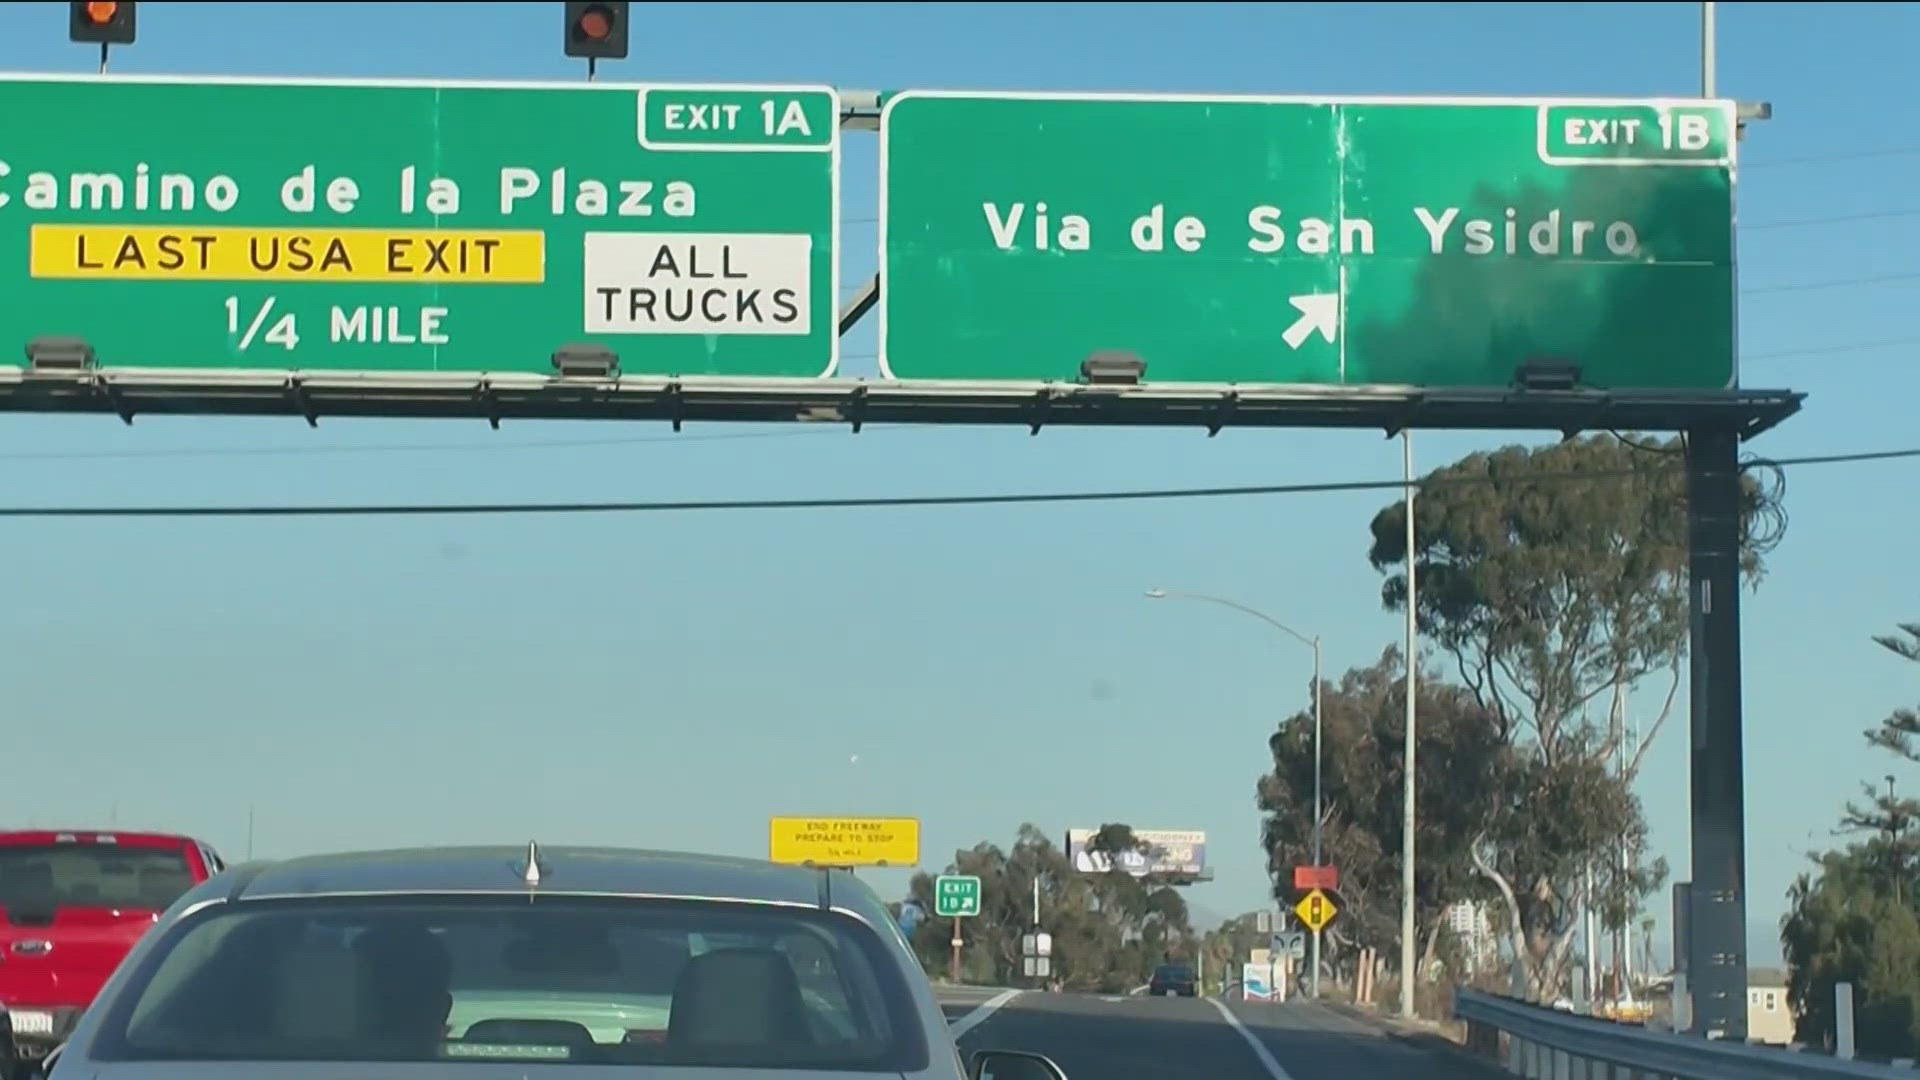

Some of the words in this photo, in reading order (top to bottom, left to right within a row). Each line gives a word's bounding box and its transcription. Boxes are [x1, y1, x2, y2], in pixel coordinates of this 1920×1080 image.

[663, 103, 742, 132] EXIT
[760, 99, 812, 136] 1A
[1564, 117, 1641, 145] EXIT
[1658, 113, 1710, 151] 1B
[281, 164, 360, 214] de
[401, 165, 461, 215] la
[500, 166, 697, 217] Plaza
[983, 202, 1091, 251] Via
[1131, 203, 1207, 252] de
[1248, 203, 1375, 255] San
[1413, 206, 1639, 256] Ysidro
[77, 234, 218, 271] LAST
[249, 236, 353, 273] USA
[387, 238, 501, 274] EXIT
[648, 243, 749, 280] ALL
[596, 286, 799, 324] TRUCKS
[331, 305, 449, 344] MILE
[795, 833, 843, 842] PREPARE
[849, 833, 862, 842] TO
[867, 833, 894, 842] STOP
[943, 882, 972, 894] EXIT
